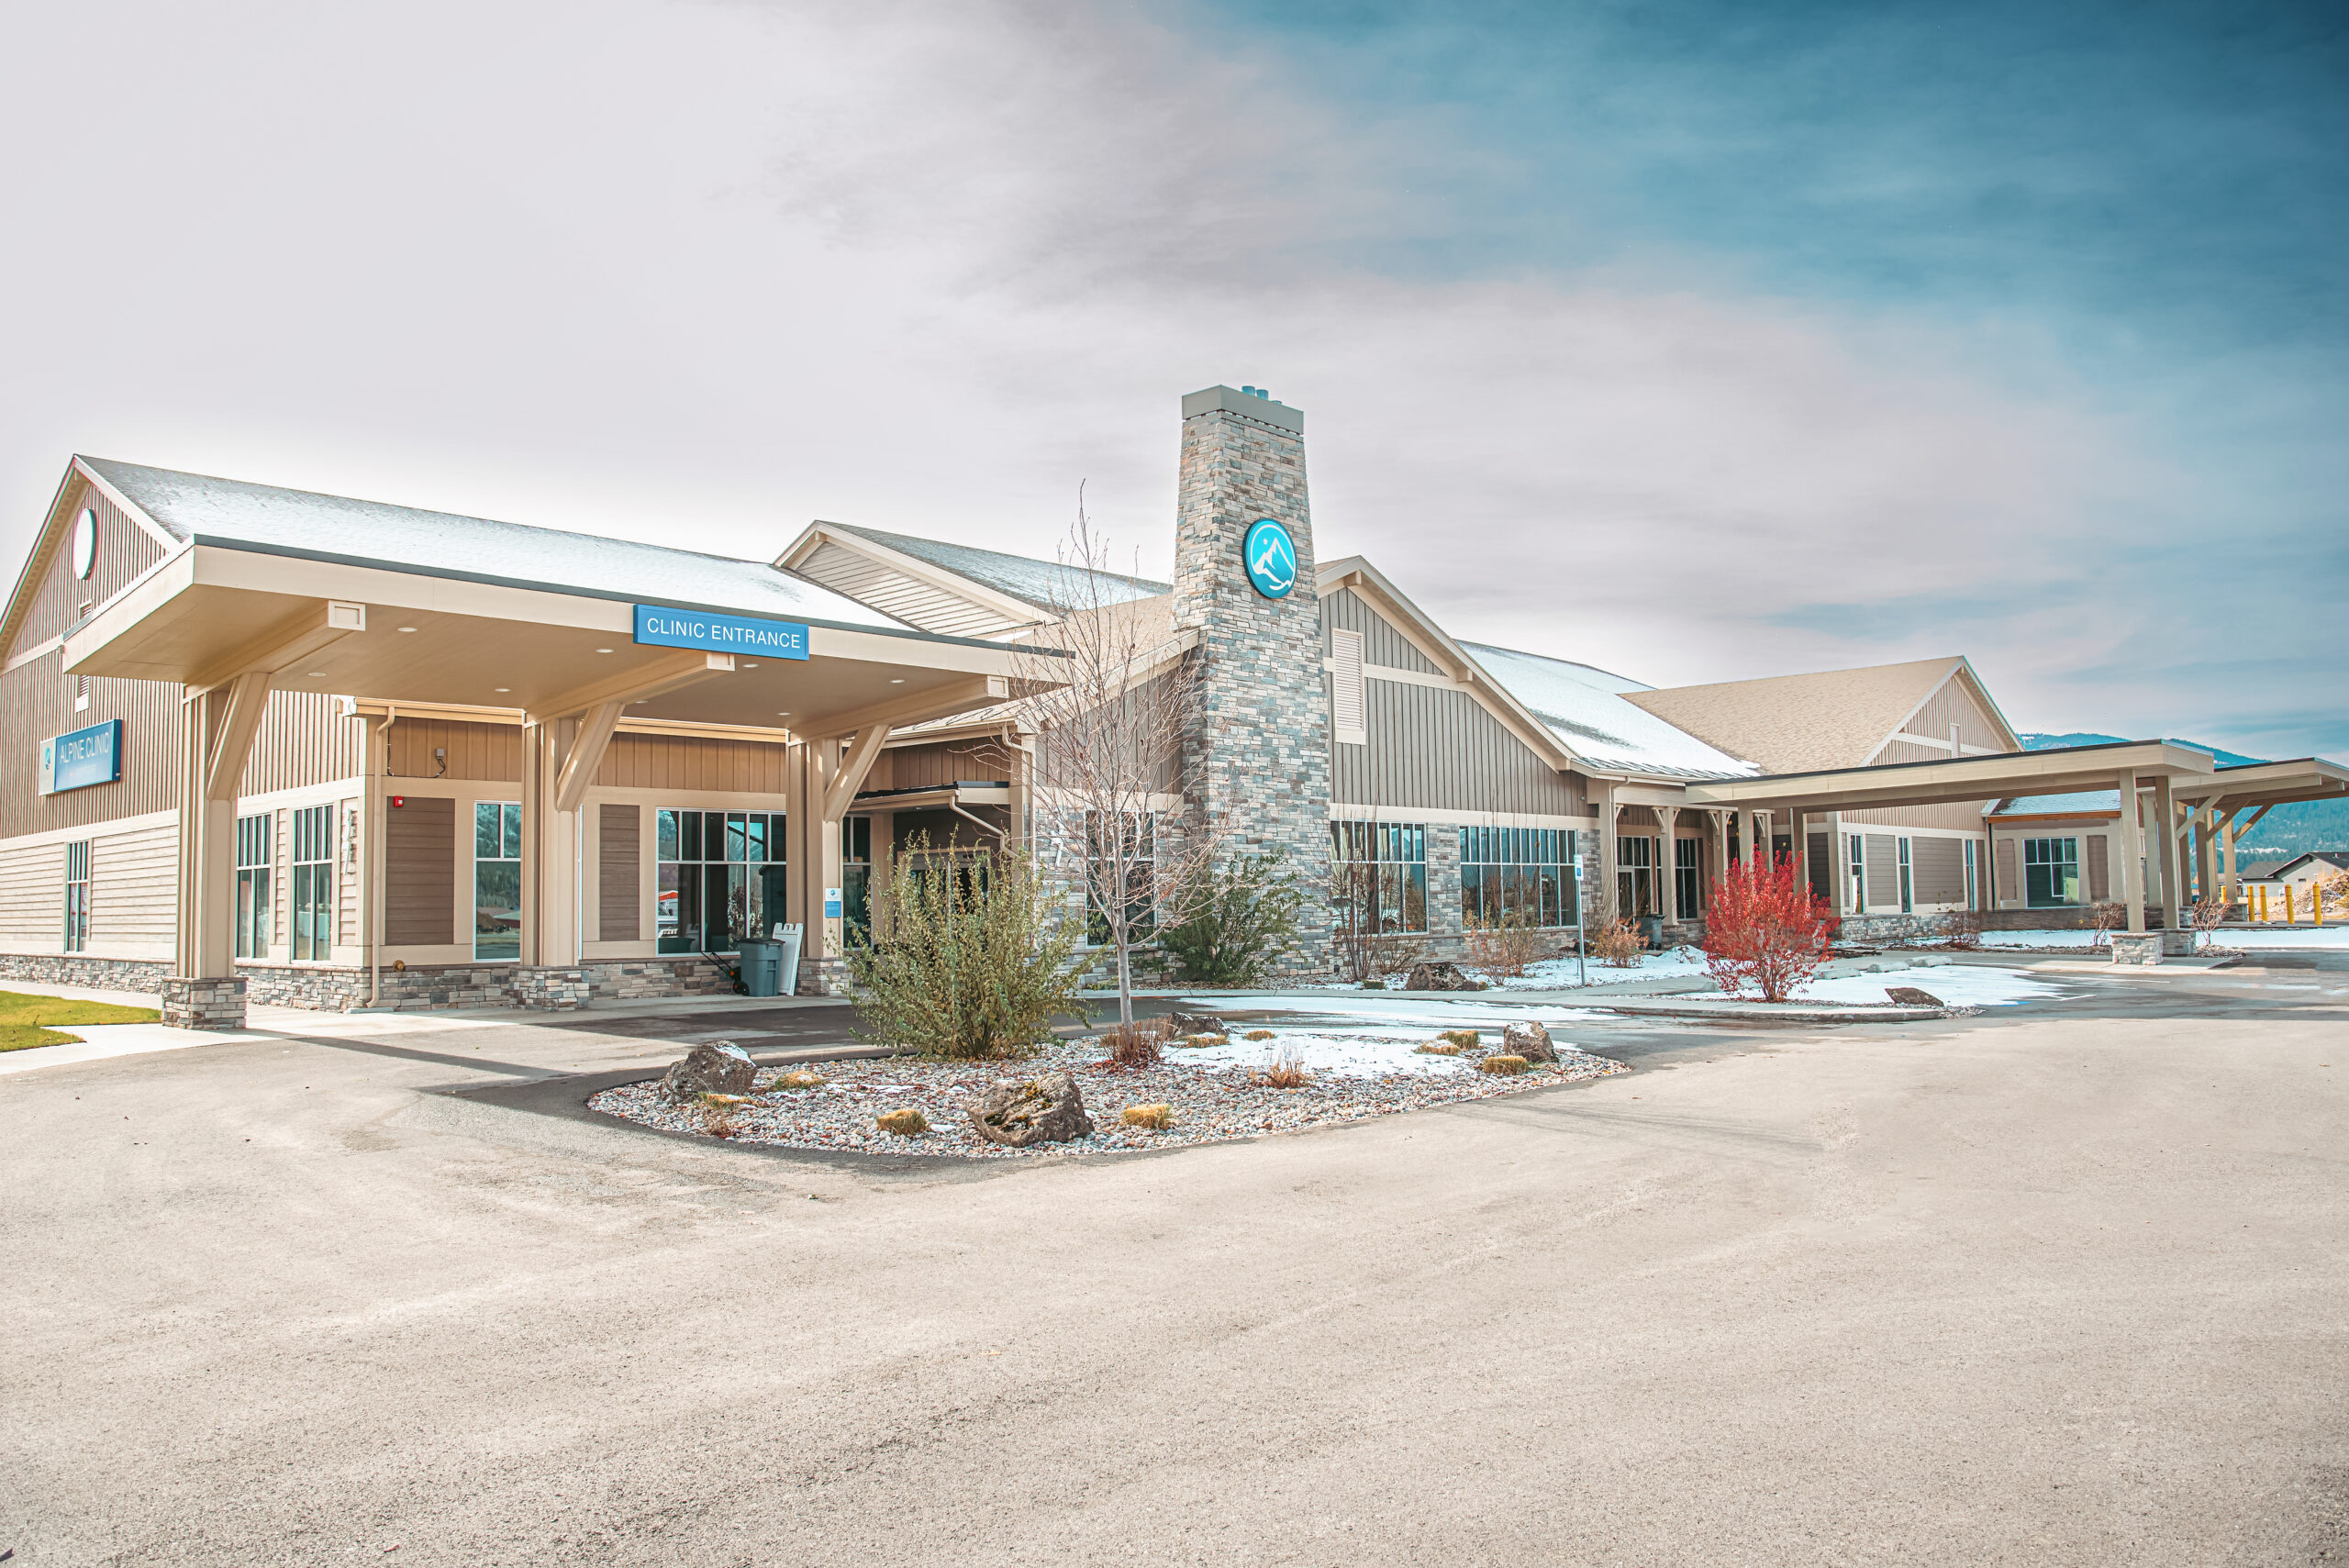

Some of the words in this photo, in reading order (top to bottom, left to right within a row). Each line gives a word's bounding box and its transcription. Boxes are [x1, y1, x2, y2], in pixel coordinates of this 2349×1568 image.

[647, 617, 705, 639] CLINIC
[711, 625, 801, 649] ENTRANCE
[60, 739, 84, 763] ALPINE
[85, 731, 109, 758] CLINIC
